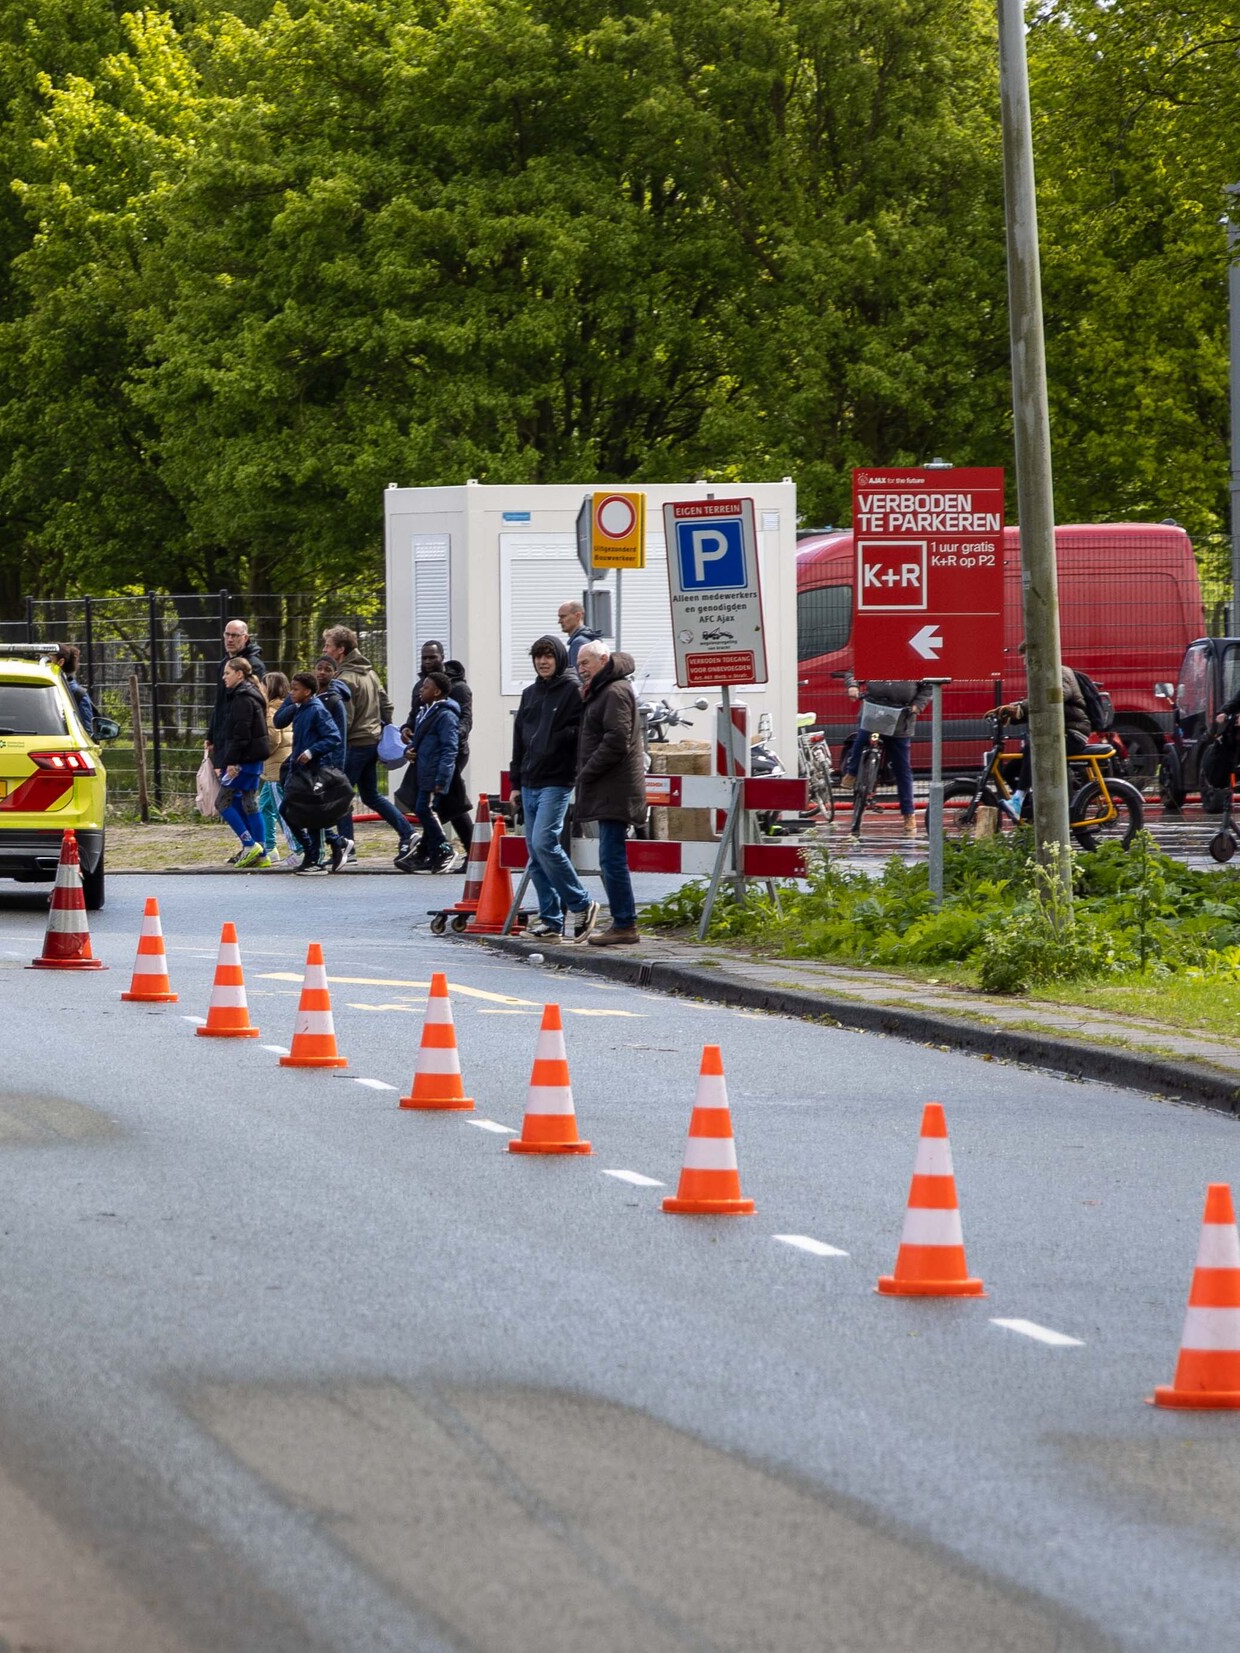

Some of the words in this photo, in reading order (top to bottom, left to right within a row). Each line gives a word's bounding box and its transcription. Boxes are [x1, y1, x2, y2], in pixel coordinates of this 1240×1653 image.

[675, 506, 702, 516] EIGEN
[704, 504, 740, 514] TERREIN
[857, 494, 972, 513] VERBODEN
[857, 513, 884, 532] TE
[888, 513, 1001, 532] PARKEREN
[930, 541, 938, 552] 1
[939, 543, 959, 553] uur
[961, 541, 995, 554] gratis
[692, 529, 729, 582] P
[931, 555, 957, 567] K+R
[959, 557, 976, 569] op
[978, 555, 996, 566] P2
[863, 563, 921, 588] K+R
[673, 595, 700, 603] Alleen
[701, 591, 758, 601] medewerkers
[697, 603, 748, 614] genodigden
[699, 615, 715, 623] AFC
[716, 615, 736, 624] Ajax
[690, 657, 722, 665] VERBODEN
[722, 655, 751, 663] TOEGANG
